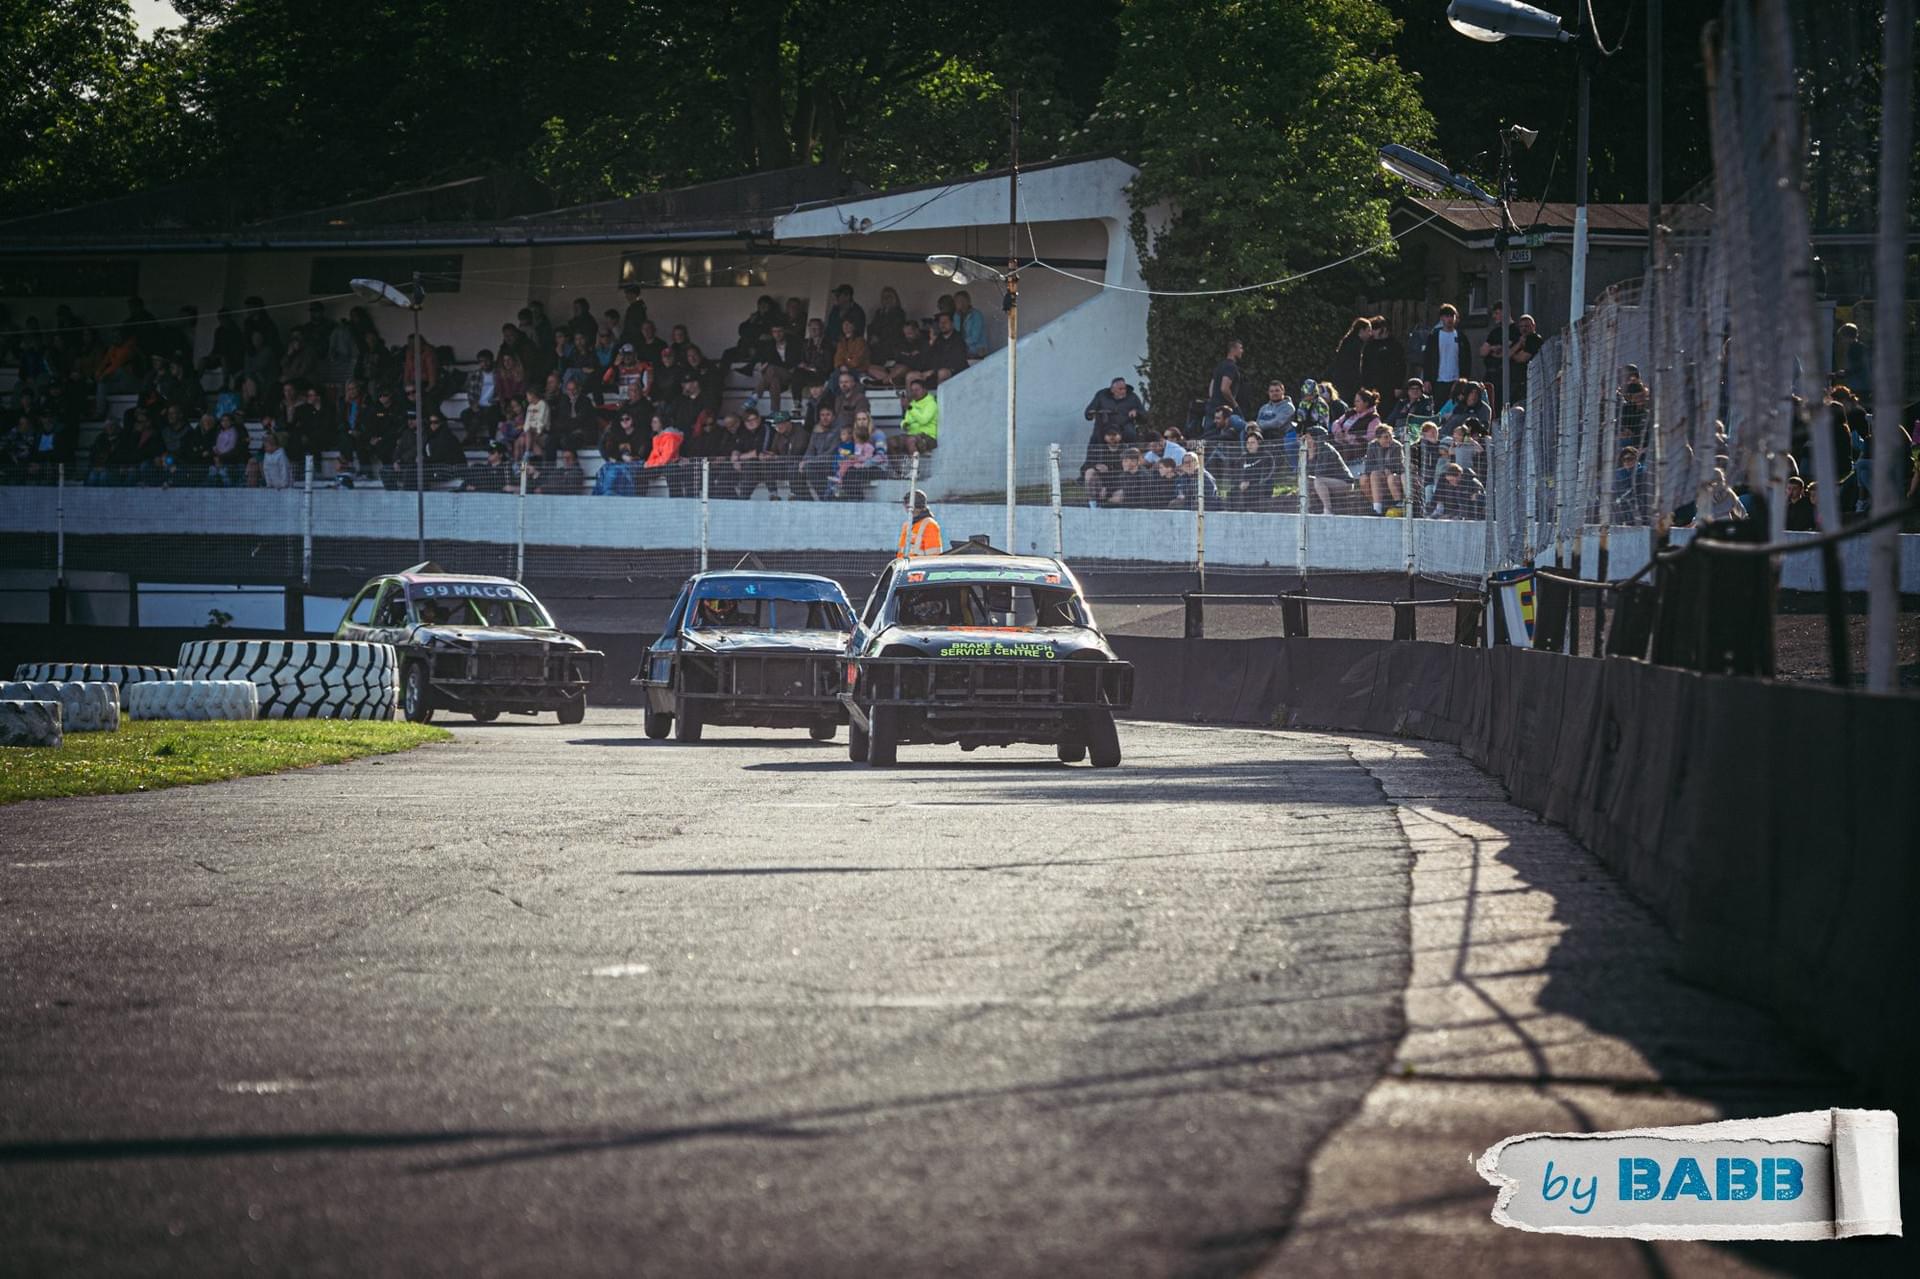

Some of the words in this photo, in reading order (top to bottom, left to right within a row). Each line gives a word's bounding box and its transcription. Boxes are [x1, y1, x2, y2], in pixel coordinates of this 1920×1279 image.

[423, 585, 449, 597] 99
[940, 648, 992, 657] SERVICE
[993, 648, 1041, 658] CENTRE
